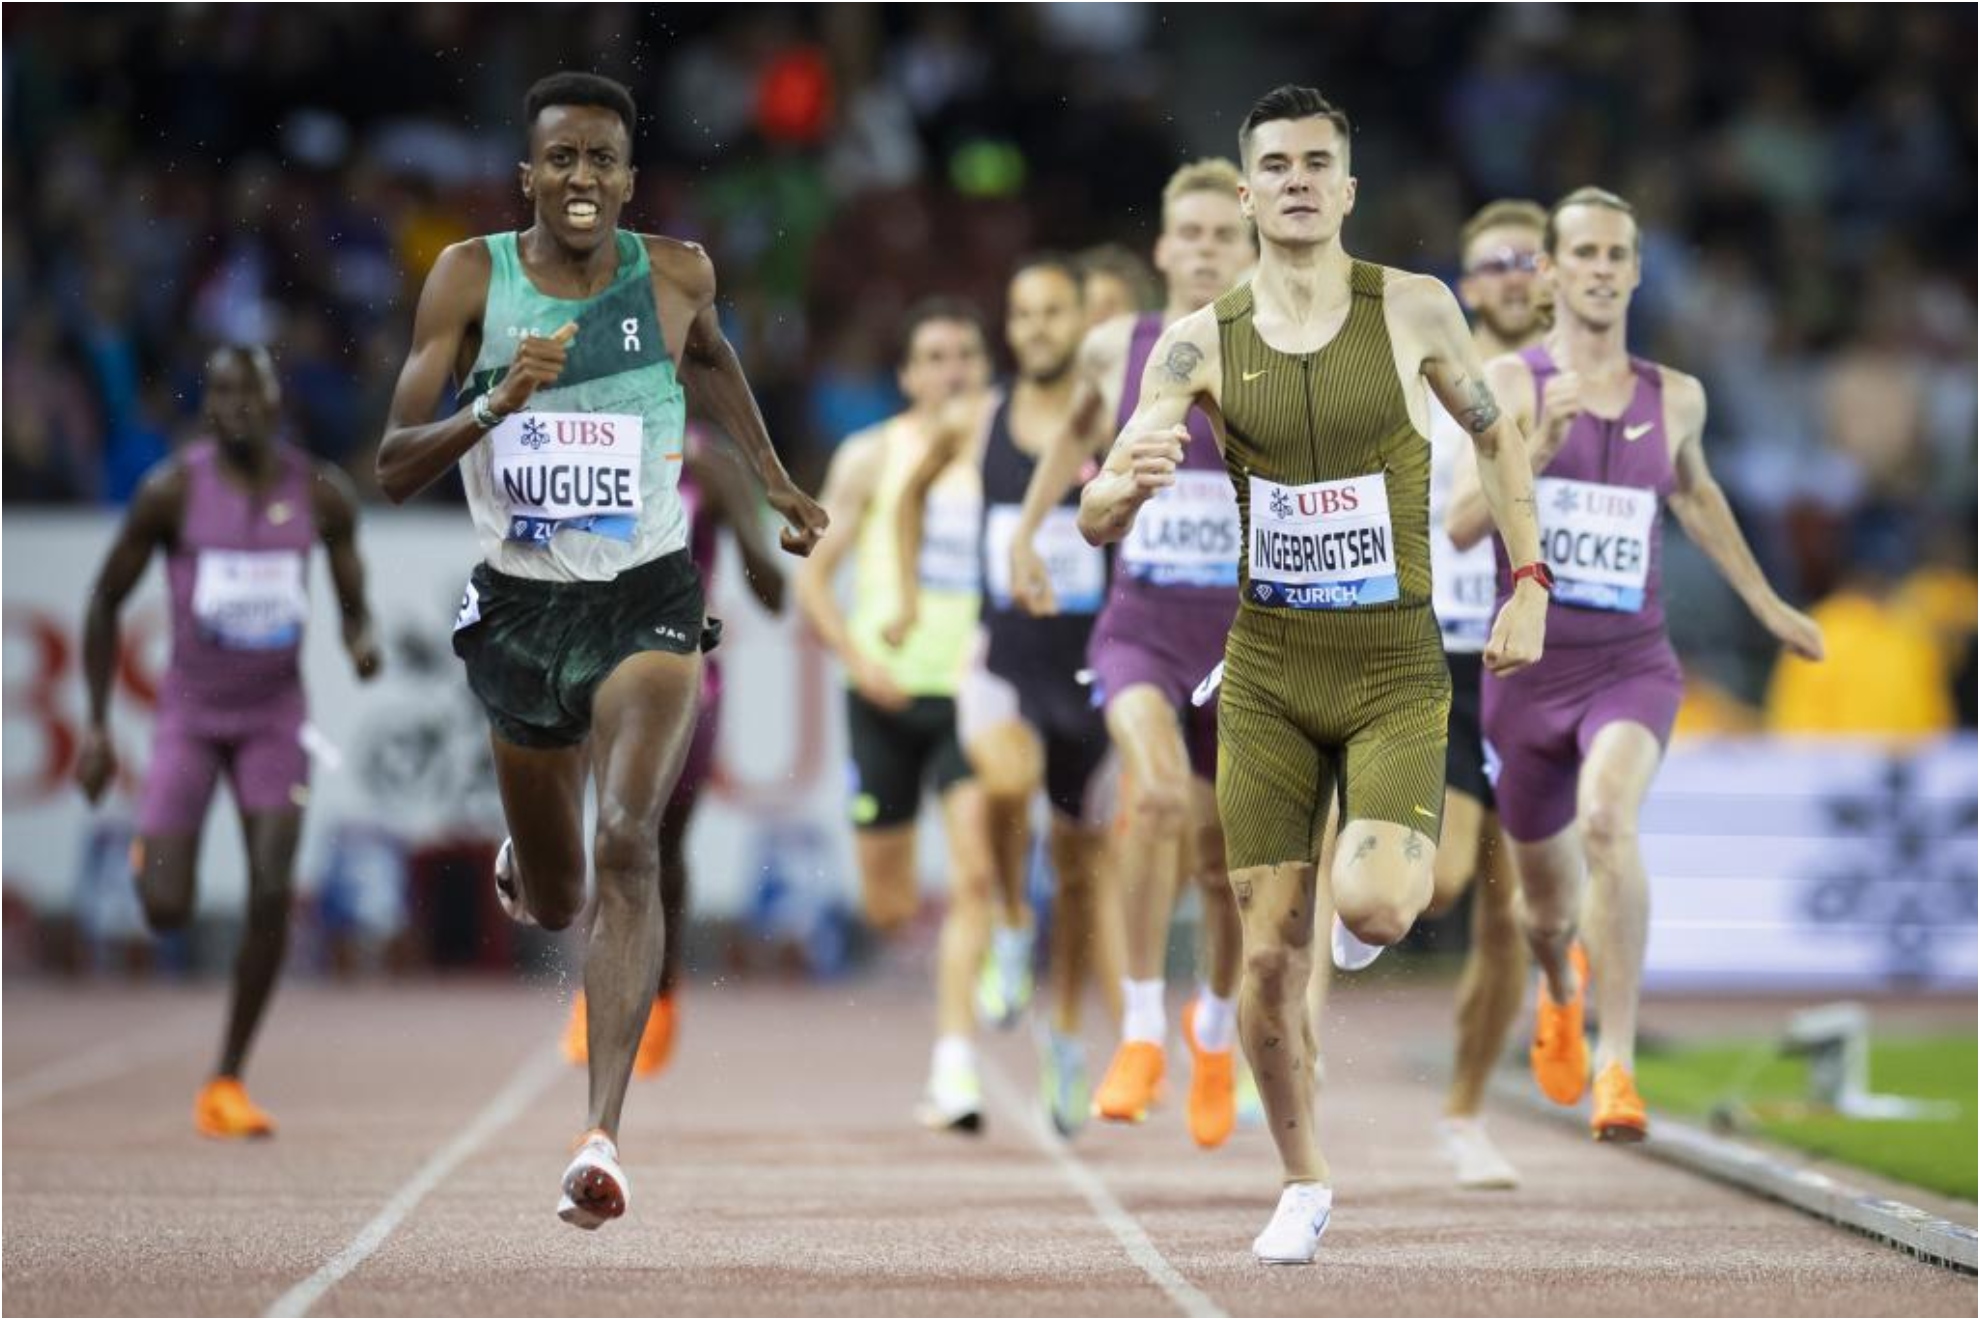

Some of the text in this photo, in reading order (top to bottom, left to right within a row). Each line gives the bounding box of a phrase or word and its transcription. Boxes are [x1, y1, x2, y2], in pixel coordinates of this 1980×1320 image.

[556, 419, 616, 446] UBS
[502, 464, 633, 508] NUGUSE
[1297, 485, 1359, 517] UBS
[1255, 526, 1387, 572] INGEBRIGTSEN
[1284, 585, 1358, 604] ZURICH
